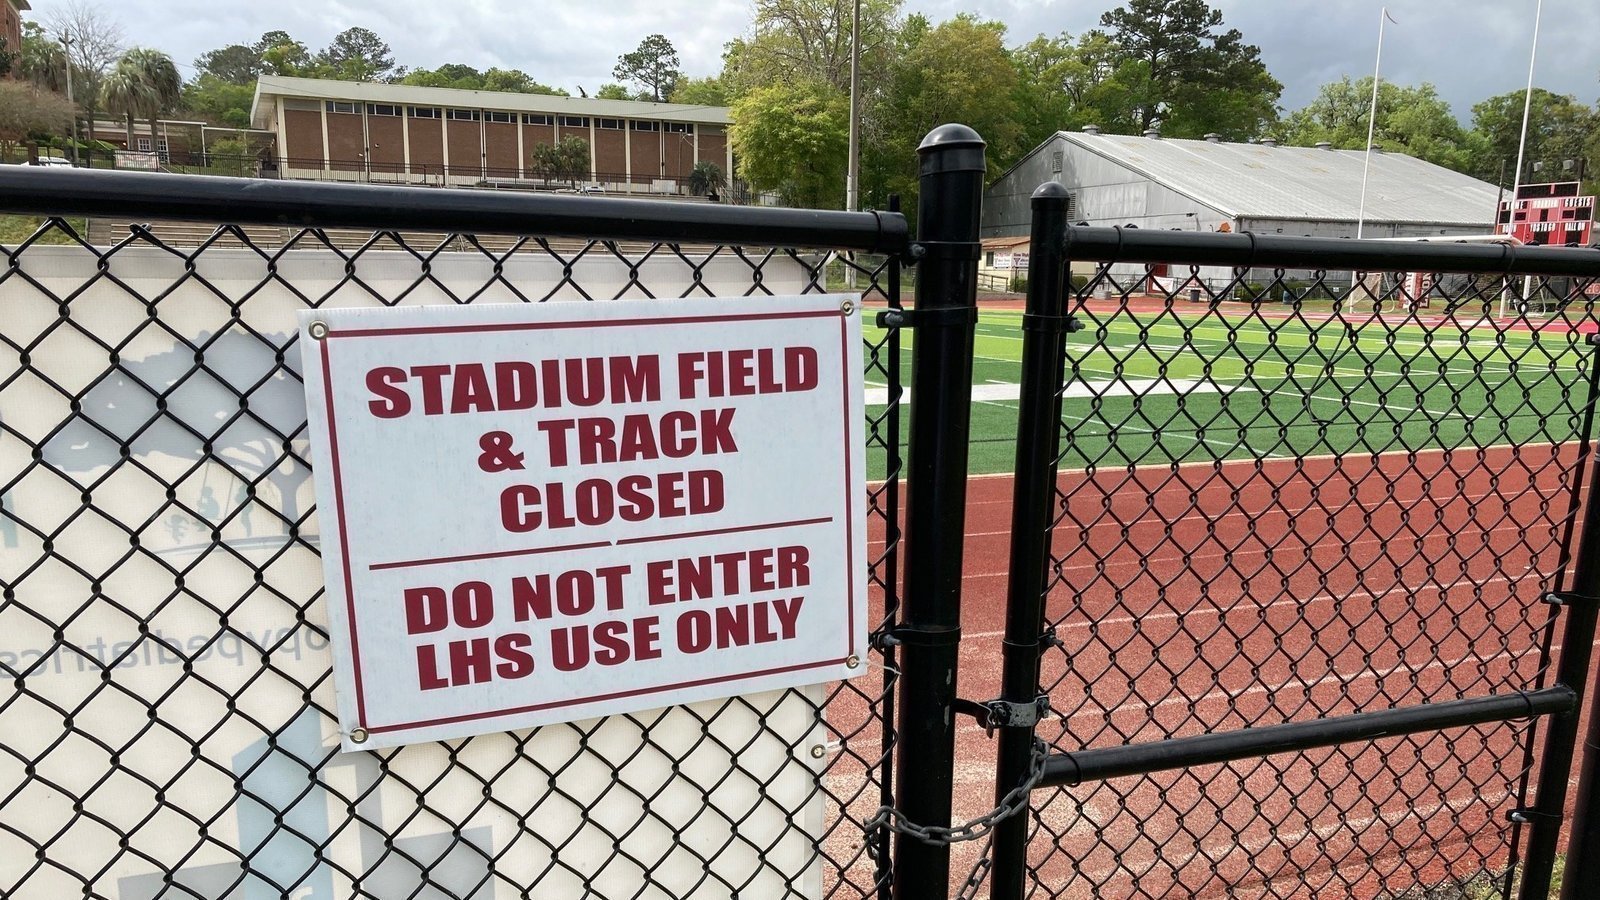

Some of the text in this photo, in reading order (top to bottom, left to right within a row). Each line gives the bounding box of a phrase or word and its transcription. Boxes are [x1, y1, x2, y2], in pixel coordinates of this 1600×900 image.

[1505, 201, 1524, 210] HME
[1564, 197, 1591, 207] GUESTS
[366, 346, 819, 419] STADIUM FIELD
[477, 407, 738, 473] & TRACK
[500, 469, 725, 533] CLOSED
[404, 545, 810, 635] DO NOT ENTER
[416, 596, 805, 691] LHS USE ONLY
